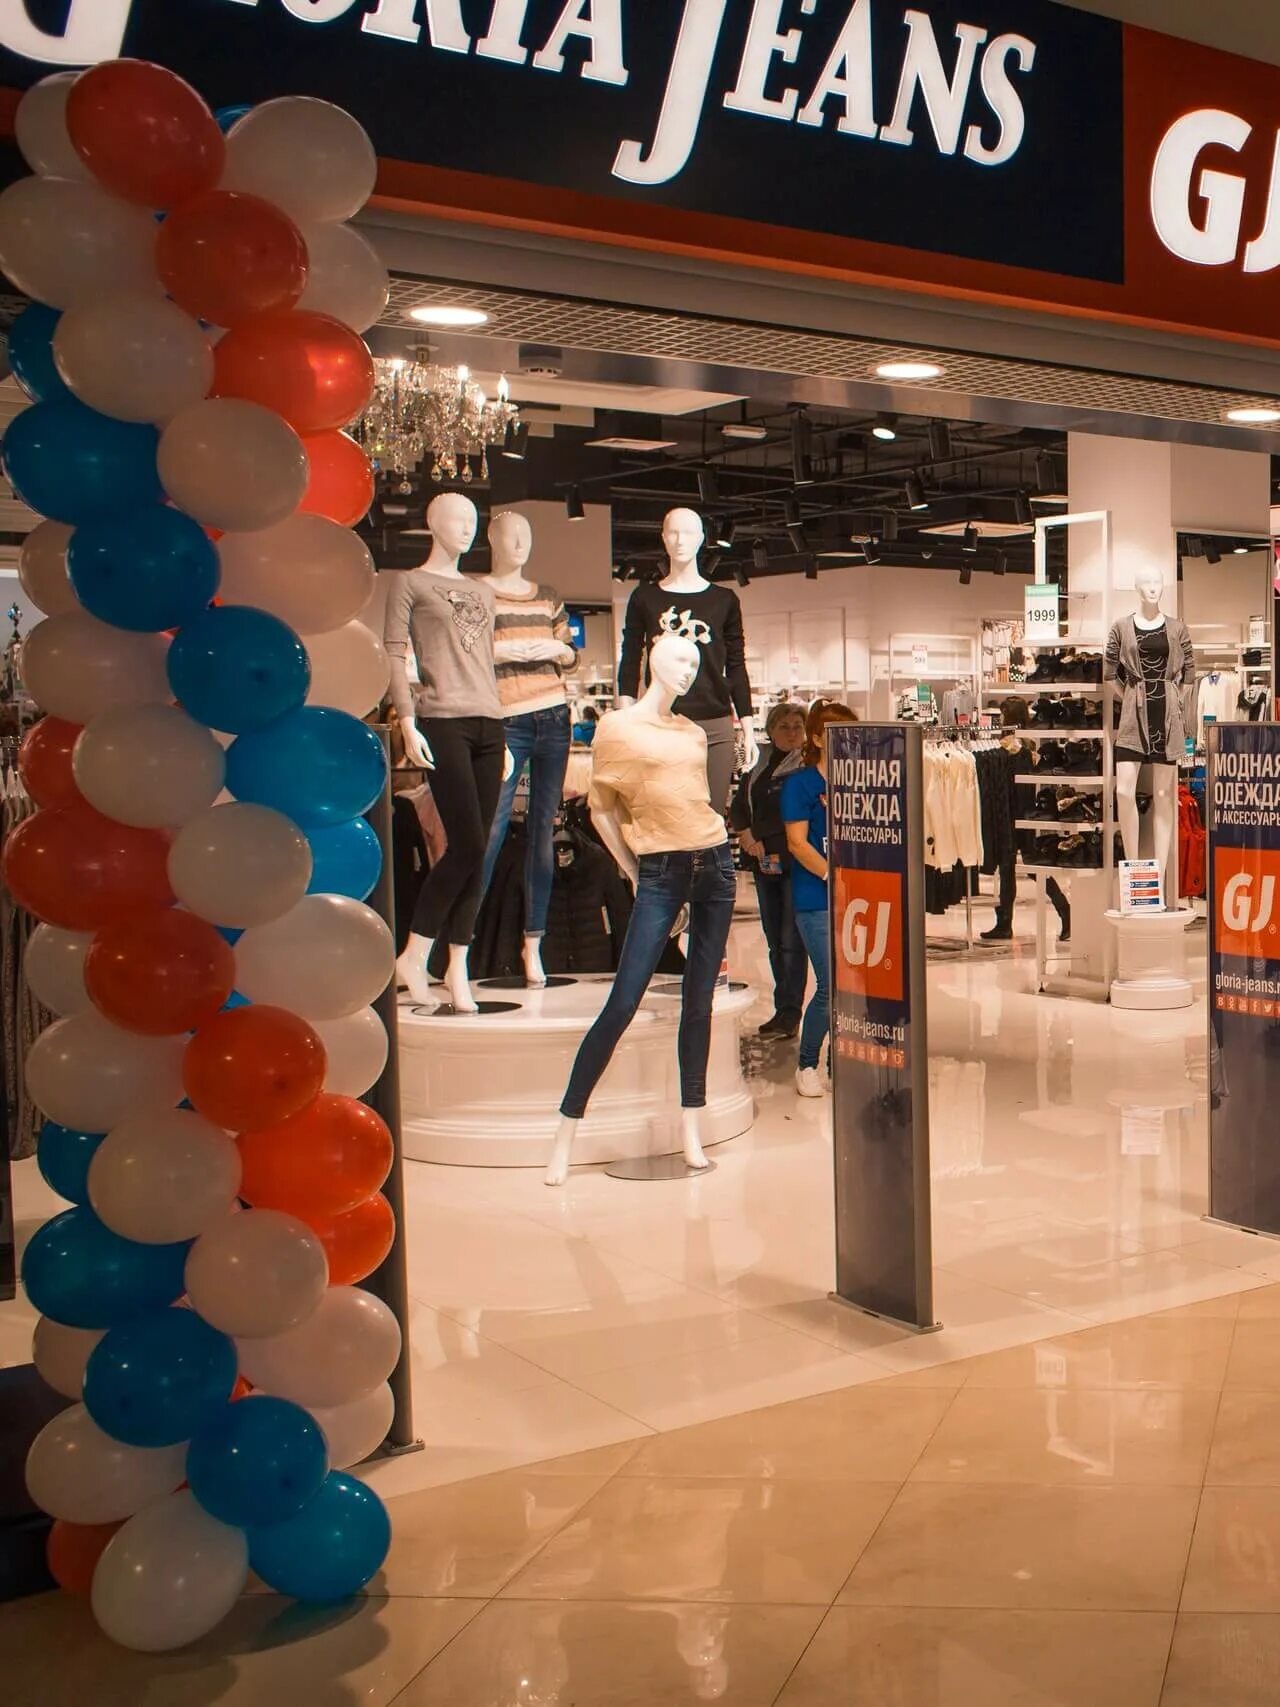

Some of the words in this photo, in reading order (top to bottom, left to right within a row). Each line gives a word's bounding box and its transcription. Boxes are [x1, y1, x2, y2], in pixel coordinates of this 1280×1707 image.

[612, 0, 1037, 185] JEANS
[1028, 609, 1056, 622] 1999
[833, 759, 901, 791] МОДНАЯ
[834, 793, 901, 824] ОДЕЖДА
[1214, 809, 1221, 823] И
[834, 825, 840, 841] И
[841, 825, 901, 845] АКСЕССУАРЫ
[837, 1010, 904, 1040] gloria-jeans.ru
